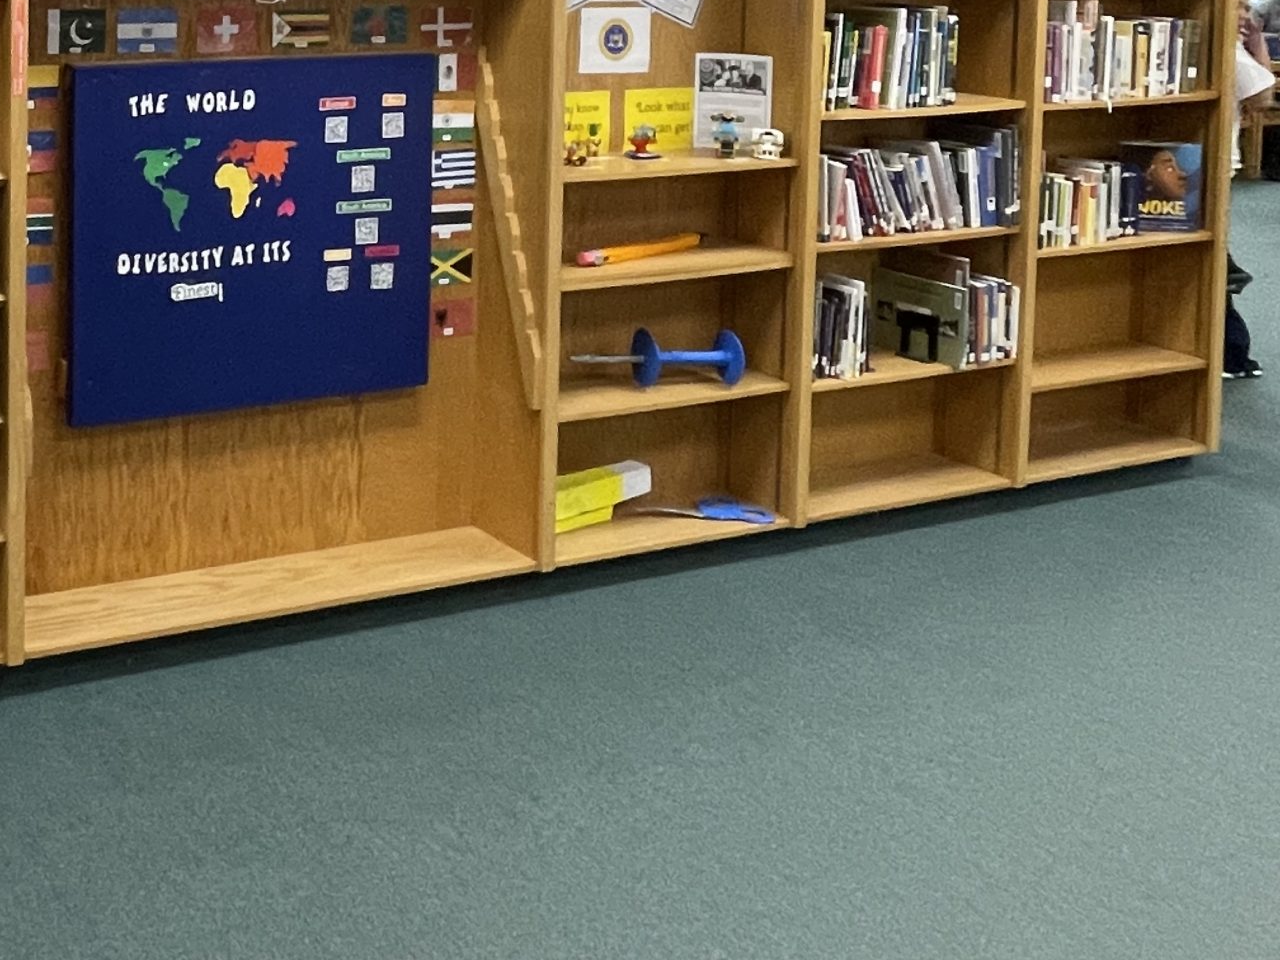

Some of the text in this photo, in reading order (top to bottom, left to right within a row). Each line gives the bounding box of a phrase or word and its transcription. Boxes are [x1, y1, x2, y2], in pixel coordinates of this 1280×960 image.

[128, 88, 256, 117] THE WORLD
[117, 240, 291, 275] DIVERSITY AT ITS
